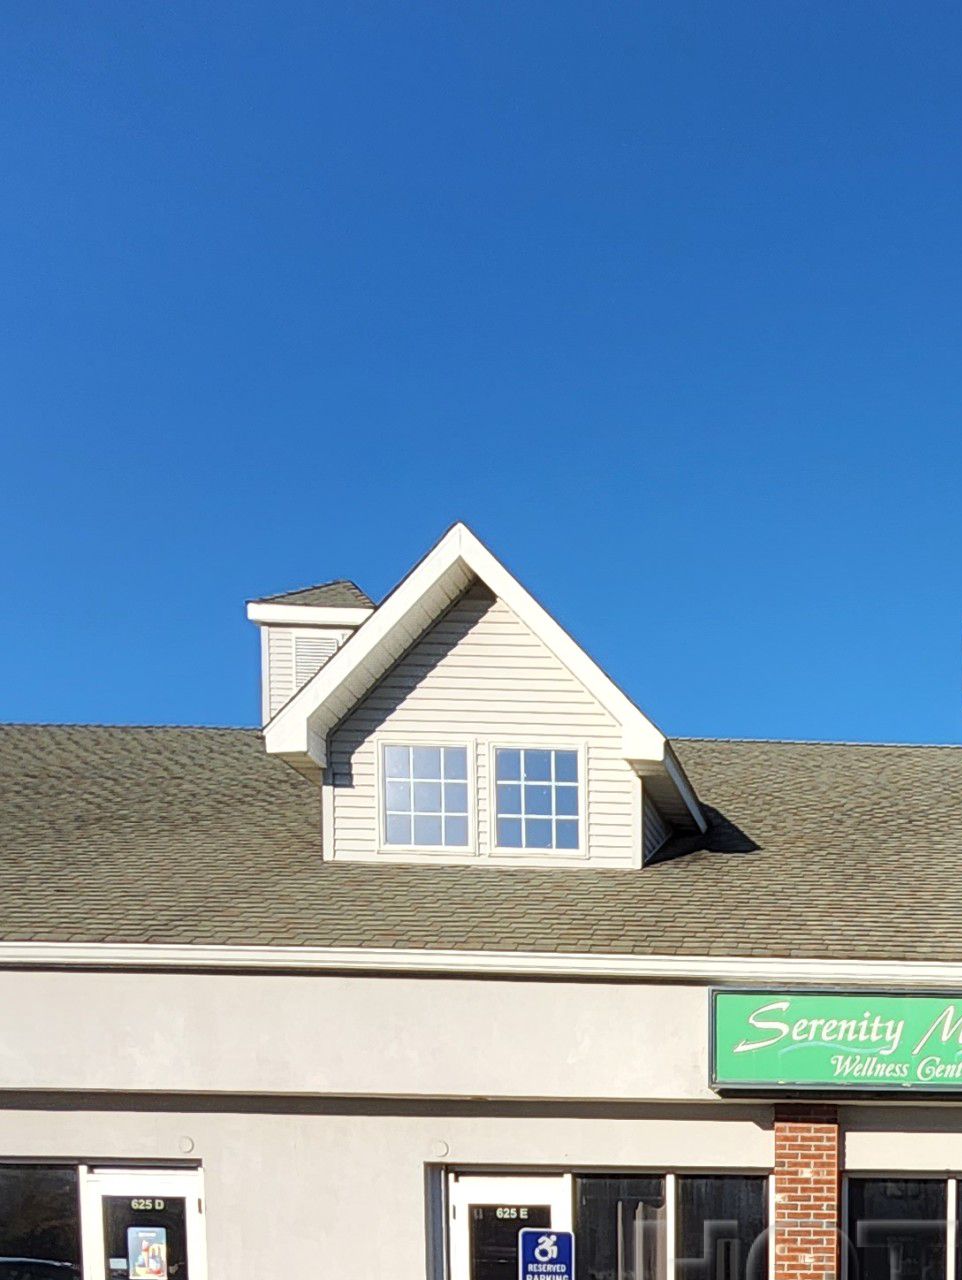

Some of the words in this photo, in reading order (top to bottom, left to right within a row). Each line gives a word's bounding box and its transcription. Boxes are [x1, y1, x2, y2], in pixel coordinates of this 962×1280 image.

[733, 1001, 905, 1055] Serenity
[830, 1055, 909, 1078] Wellness
[131, 1199, 152, 1210] 625
[154, 1200, 165, 1210] D
[496, 1208, 518, 1219] 625
[519, 1208, 528, 1219] E
[528, 1264, 567, 1272] RESERVED
